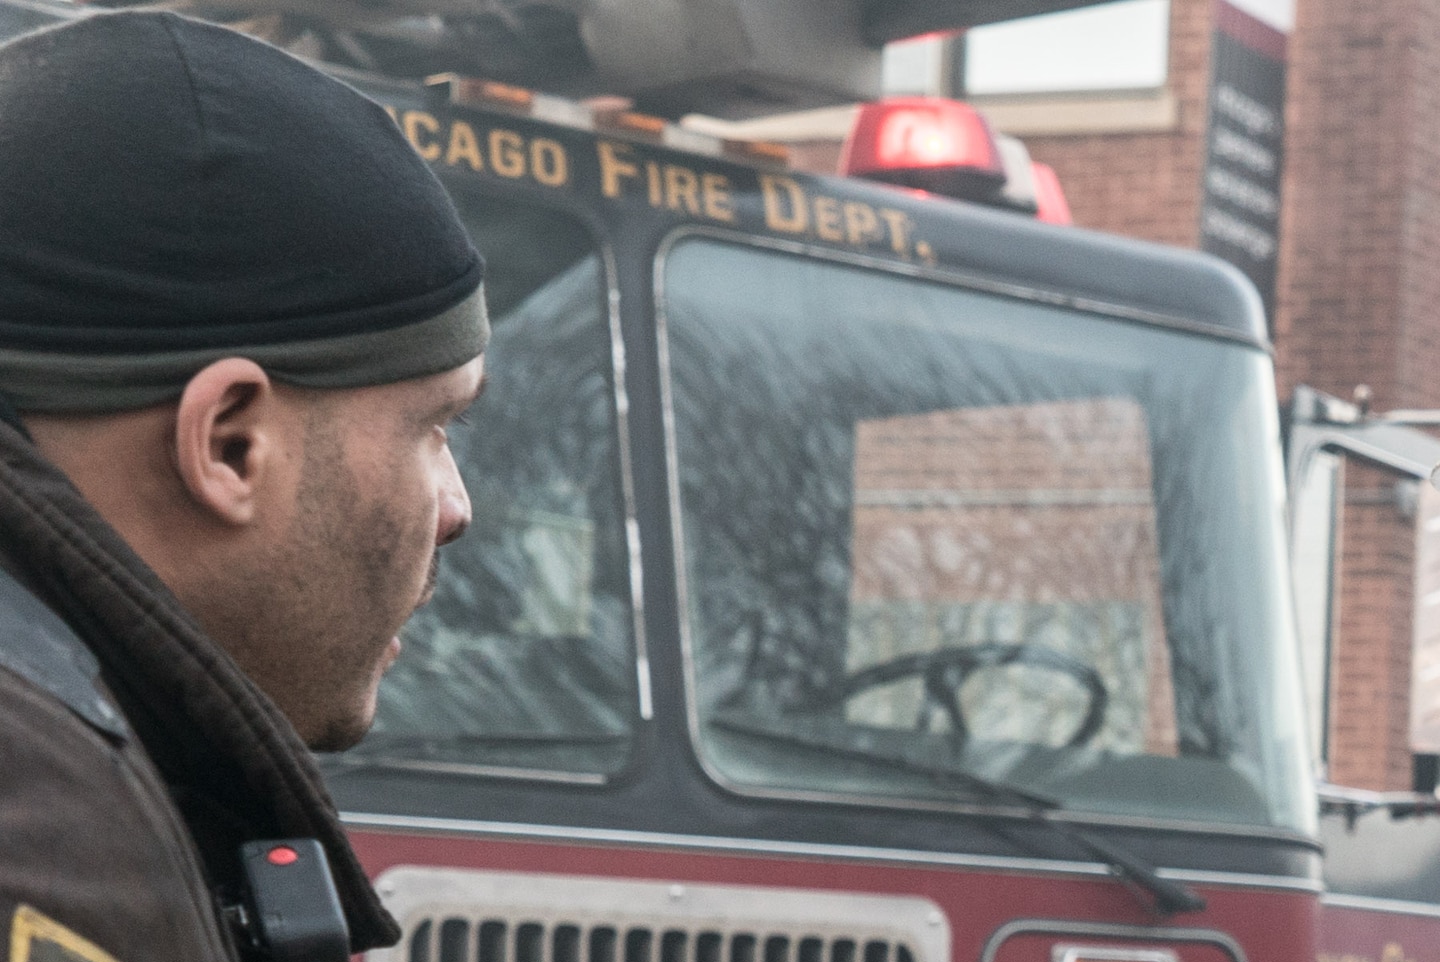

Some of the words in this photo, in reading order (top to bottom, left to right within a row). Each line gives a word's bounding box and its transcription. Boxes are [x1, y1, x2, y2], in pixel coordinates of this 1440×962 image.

[385, 104, 568, 188] CAGO
[597, 140, 737, 223] FIRE
[758, 173, 937, 267] DEPT.
